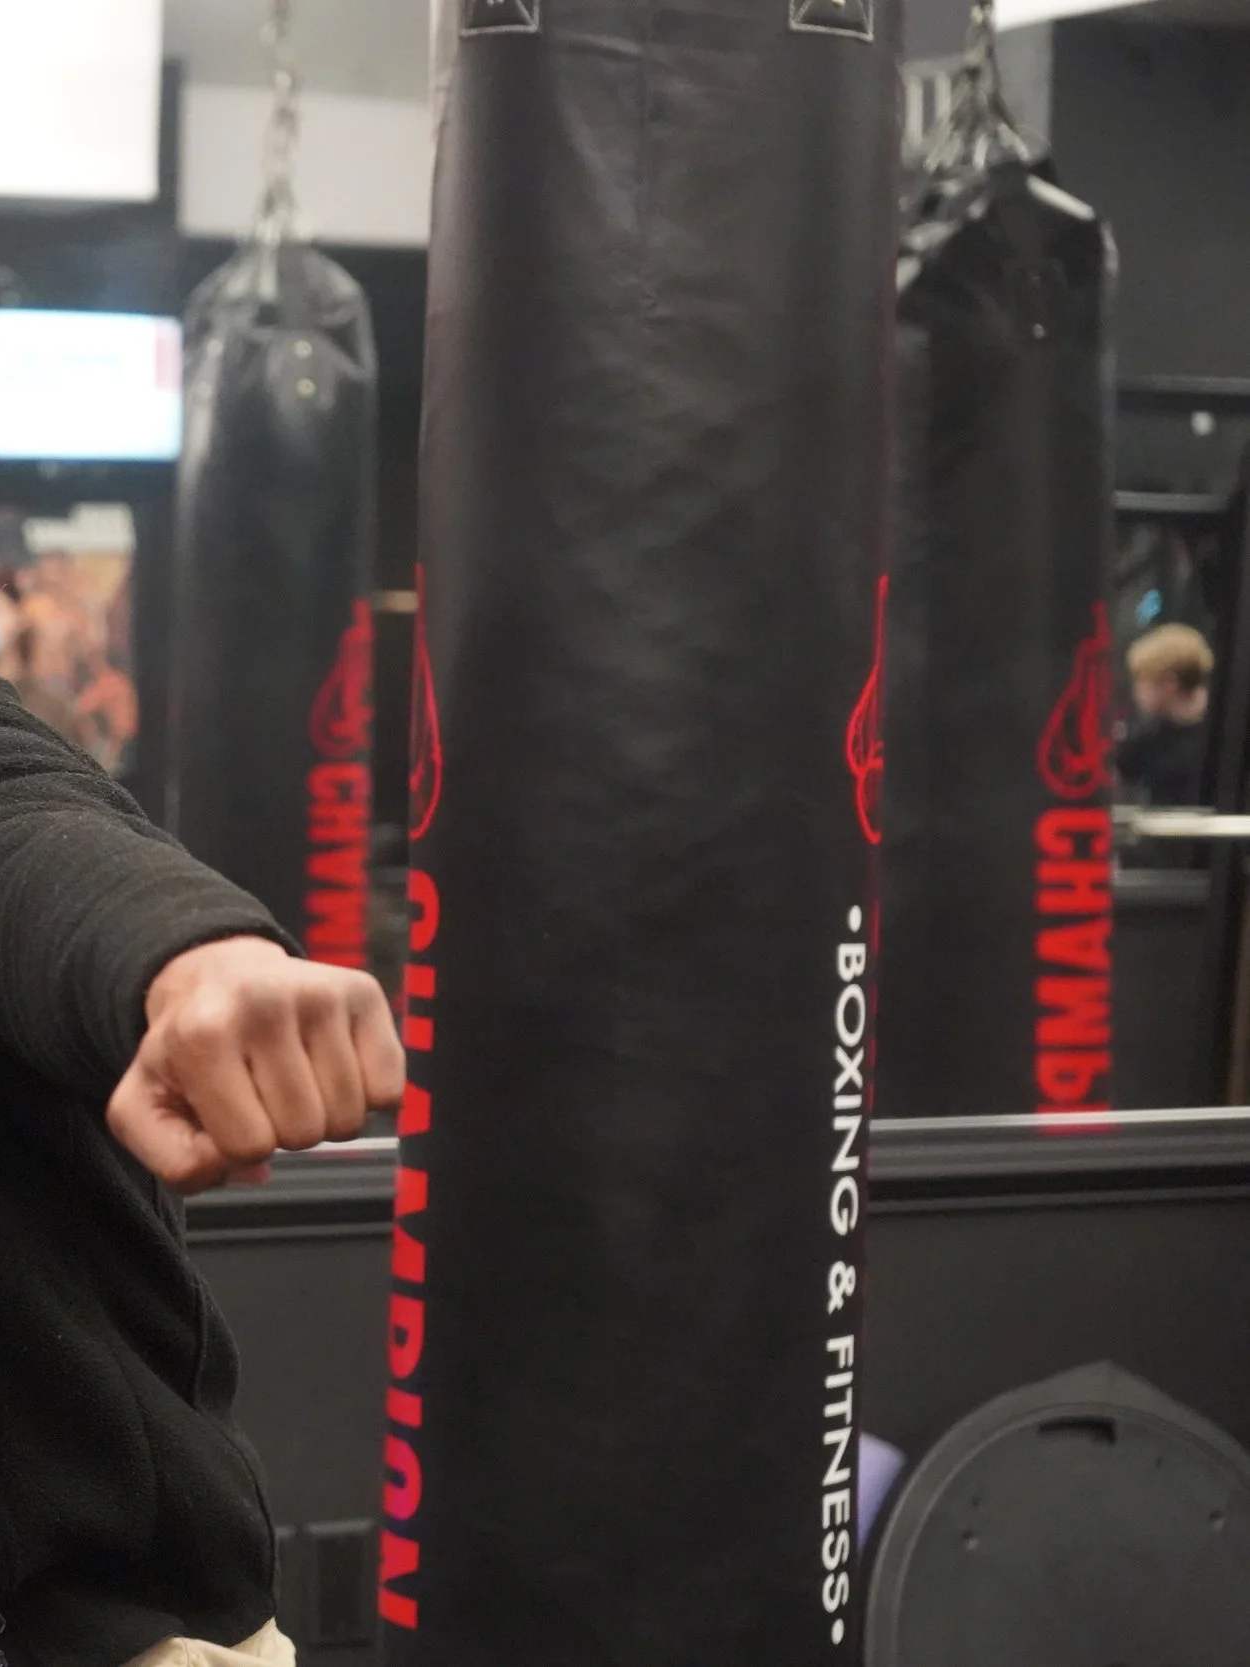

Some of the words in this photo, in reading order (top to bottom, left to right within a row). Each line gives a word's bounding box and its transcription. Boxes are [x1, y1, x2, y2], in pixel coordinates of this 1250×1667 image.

[829, 941, 867, 1237] BOXING
[827, 1260, 857, 1315] &
[821, 1333, 855, 1614] FITNESS
